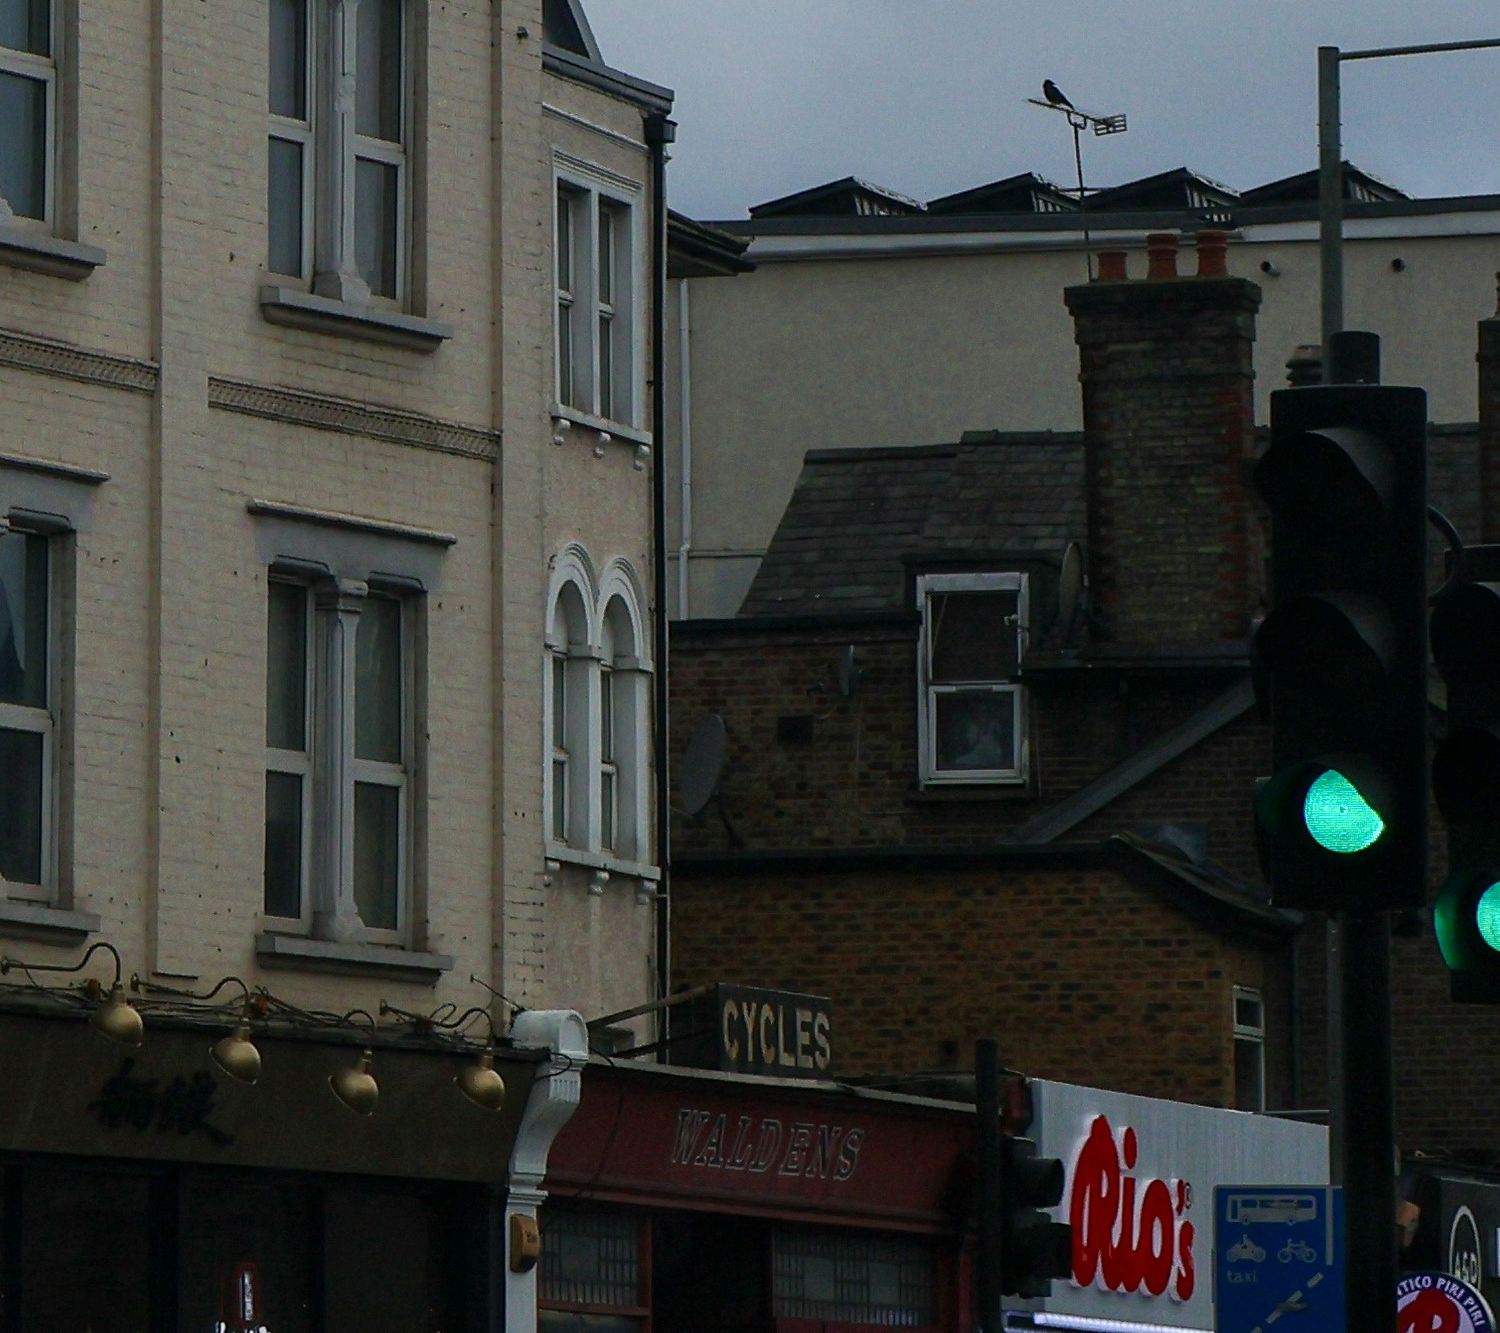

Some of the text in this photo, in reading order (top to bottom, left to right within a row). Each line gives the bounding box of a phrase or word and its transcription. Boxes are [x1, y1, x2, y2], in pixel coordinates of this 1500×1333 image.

[722, 998, 831, 1071] CYCLES
[672, 1109, 865, 1181] WALDENS
[1070, 1114, 1194, 1302] Rio's
[1226, 1269, 1257, 1284] taxi
[1435, 1276, 1467, 1301] PIRI
[1463, 1296, 1486, 1327] PIRI
